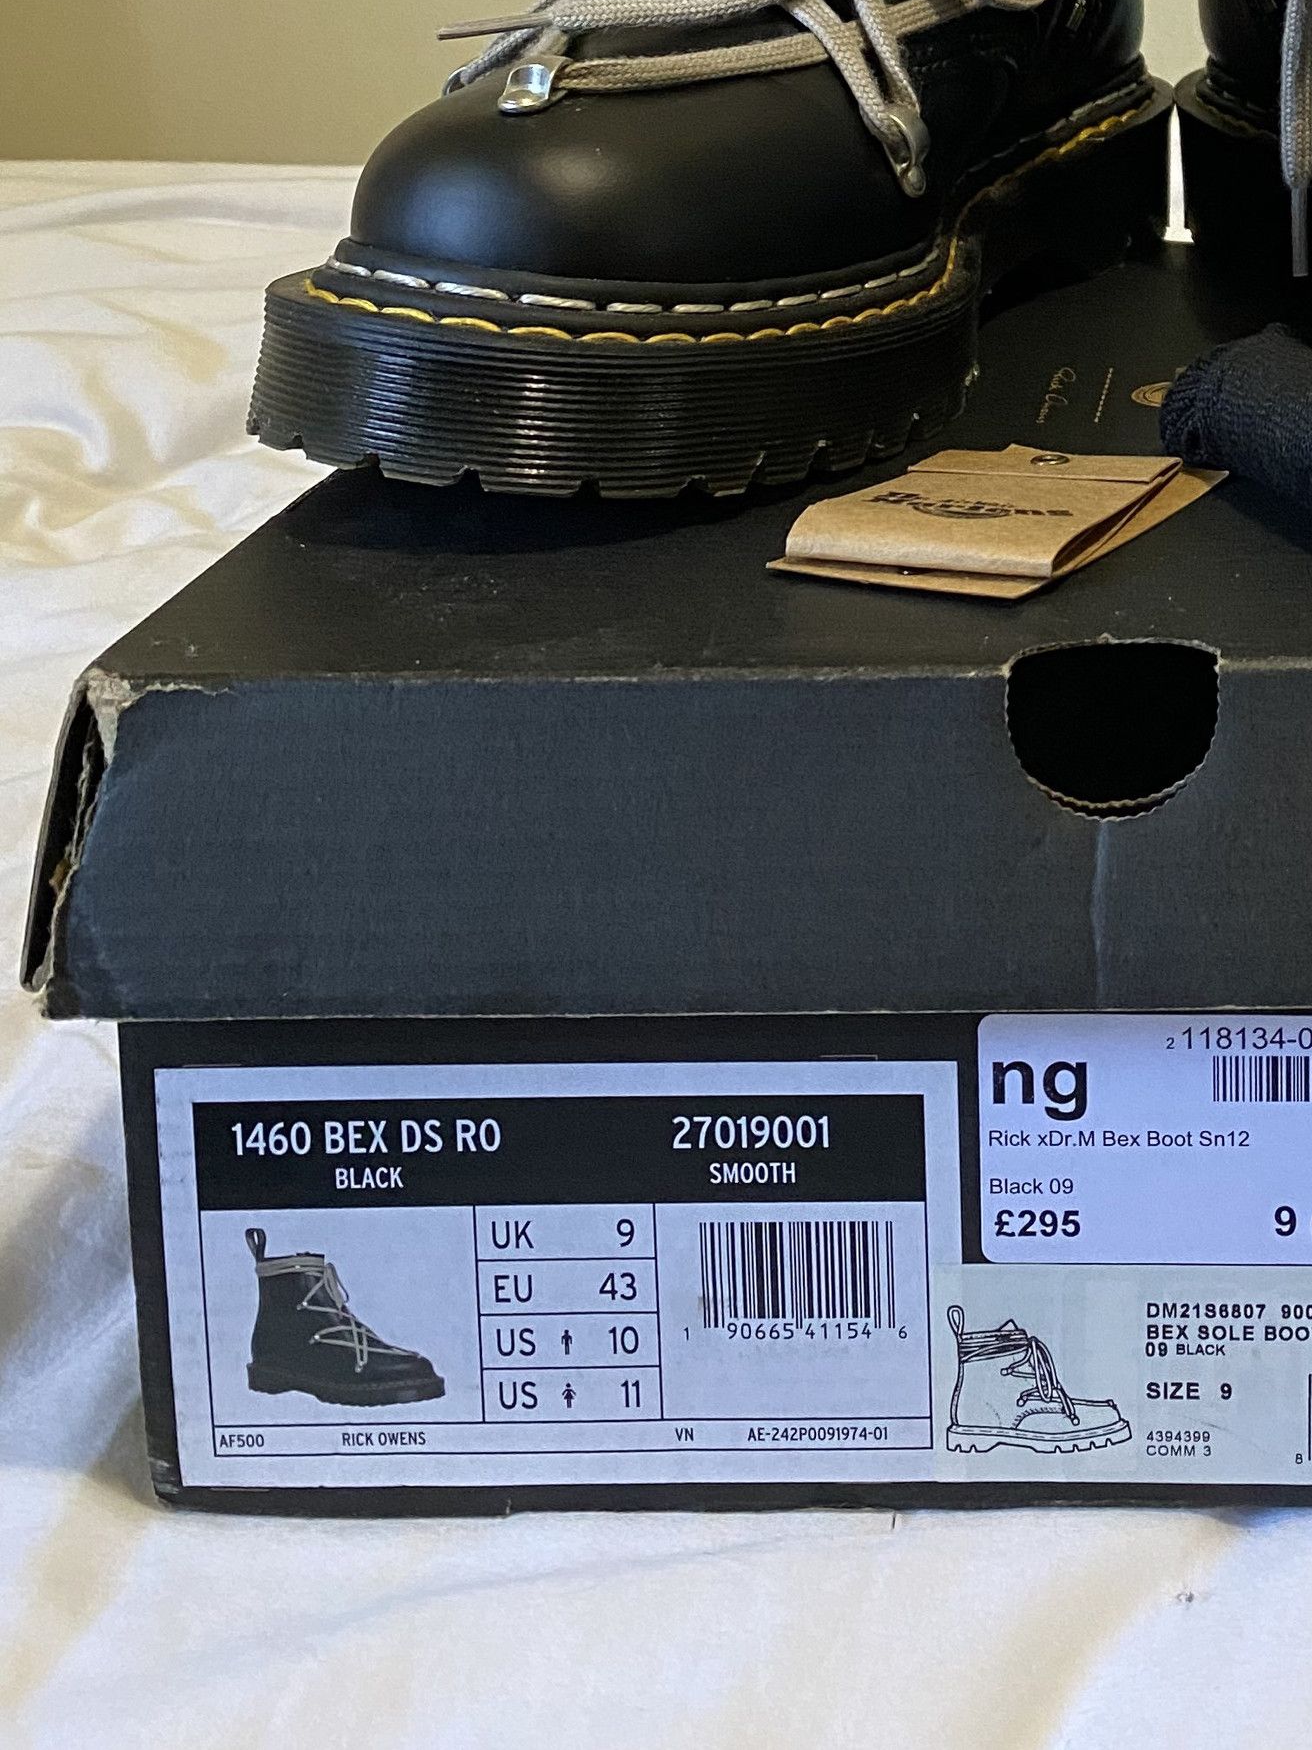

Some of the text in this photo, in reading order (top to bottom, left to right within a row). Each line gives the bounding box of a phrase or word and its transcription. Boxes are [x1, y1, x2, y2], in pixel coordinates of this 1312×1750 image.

[992, 1060, 1088, 1122] ng
[231, 1118, 501, 1156] 1460 BEX DS RO
[671, 1115, 830, 1150] 27019001
[988, 1130, 1251, 1147] Rick xDr.M Bex Boot Sn12
[335, 1166, 404, 1190] BLACK
[709, 1162, 797, 1185] SMOOTH
[989, 1178, 1074, 1195] Black 09
[994, 1209, 1081, 1238] £295
[1274, 1205, 1297, 1237] 9
[491, 1218, 635, 1250] UK 9
[493, 1272, 638, 1304] EU 43
[1146, 1302, 1266, 1320] DM21S6807
[496, 1326, 639, 1357] US 10
[727, 1322, 795, 1340] 90665
[804, 1322, 872, 1340] 41154
[898, 1325, 908, 1340] 6
[1146, 1324, 1189, 1341] BEX
[1197, 1325, 1255, 1341] SOLE
[1145, 1341, 1226, 1357] 09 BLACK
[498, 1379, 641, 1410] US 11
[1146, 1381, 1233, 1400] SIZE 9
[219, 1426, 889, 1448] AF500 RICK OWENS VN AE-242P0091974-01
[1146, 1430, 1211, 1442] 4394399
[1146, 1445, 1212, 1457] COMM 3
